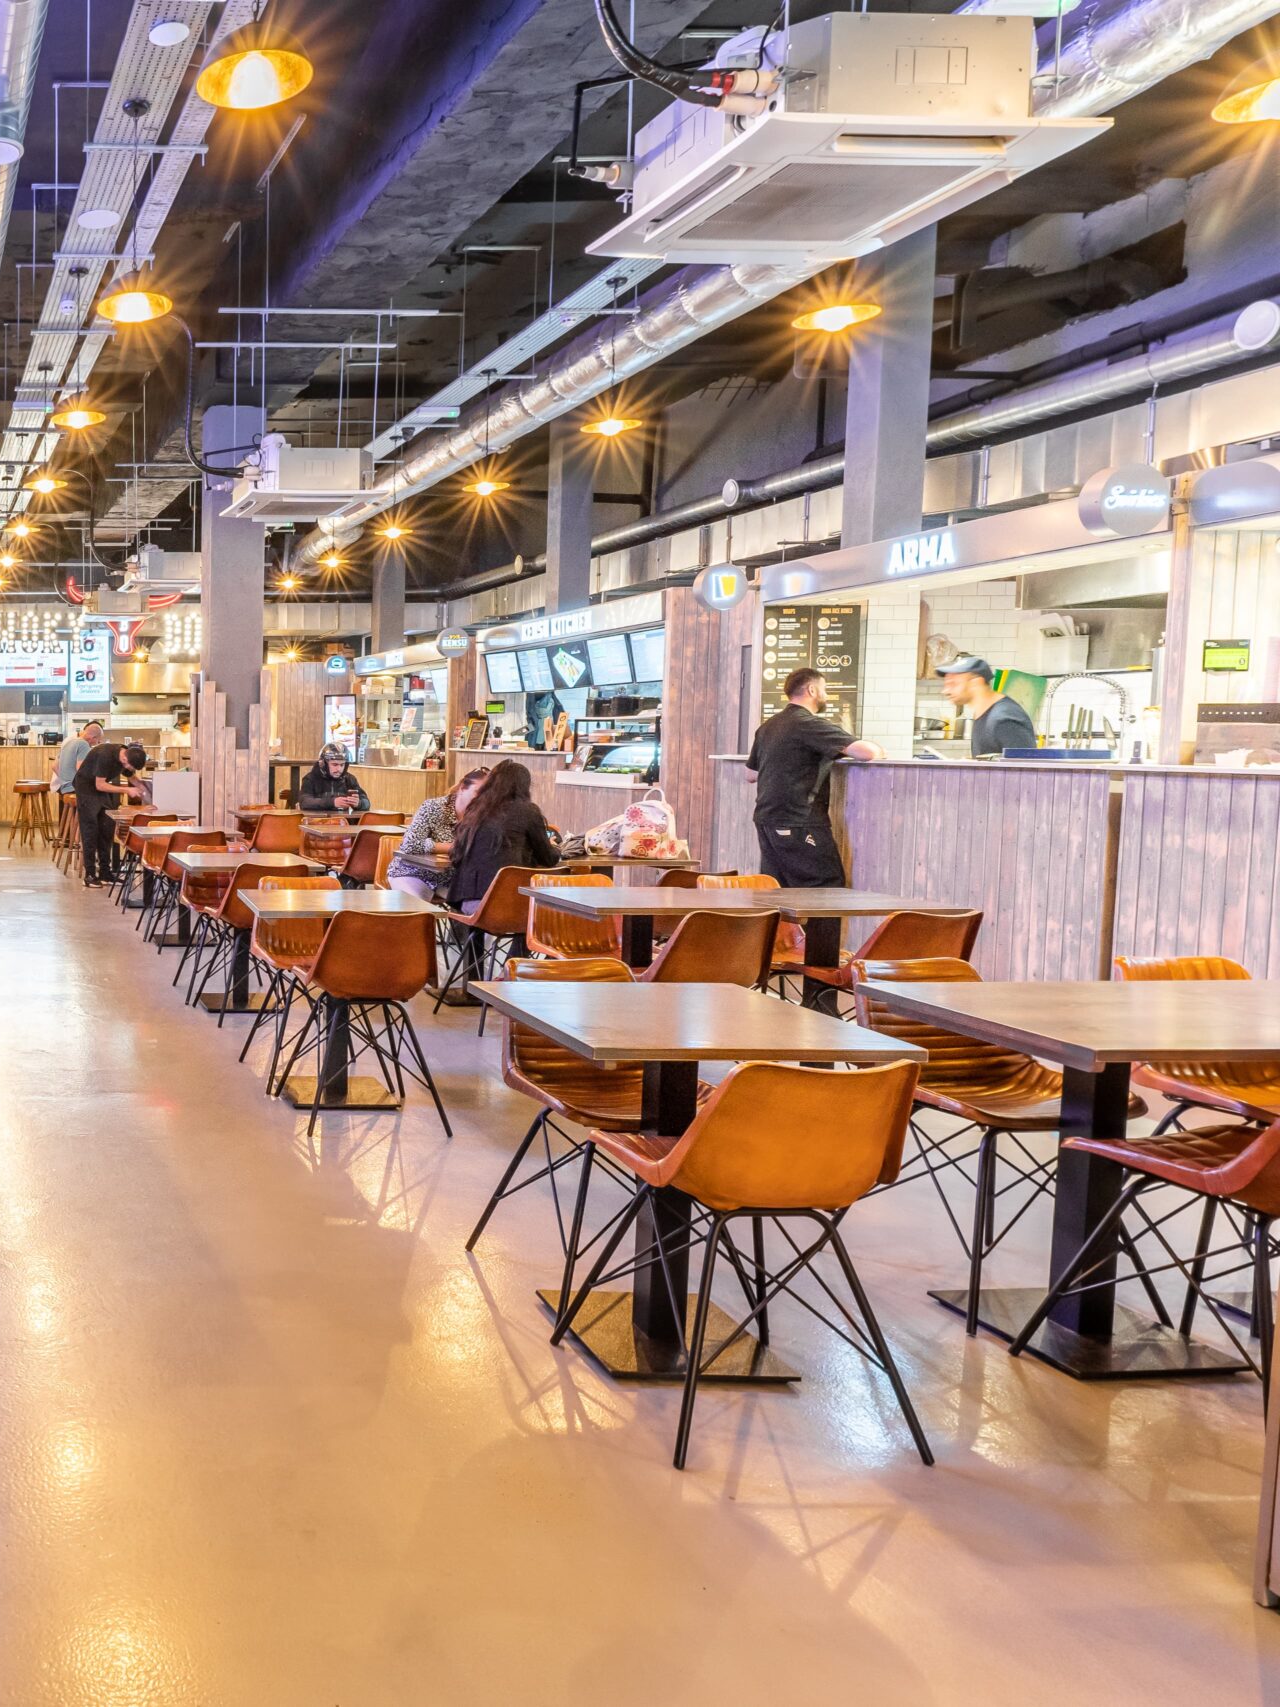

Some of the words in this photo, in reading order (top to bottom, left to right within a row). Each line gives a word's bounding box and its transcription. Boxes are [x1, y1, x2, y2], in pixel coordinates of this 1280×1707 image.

[887, 531, 957, 575] ARMA
[551, 610, 593, 637] KITCHEN
[442, 638, 468, 647] KENSU
[75, 670, 96, 682] 20
